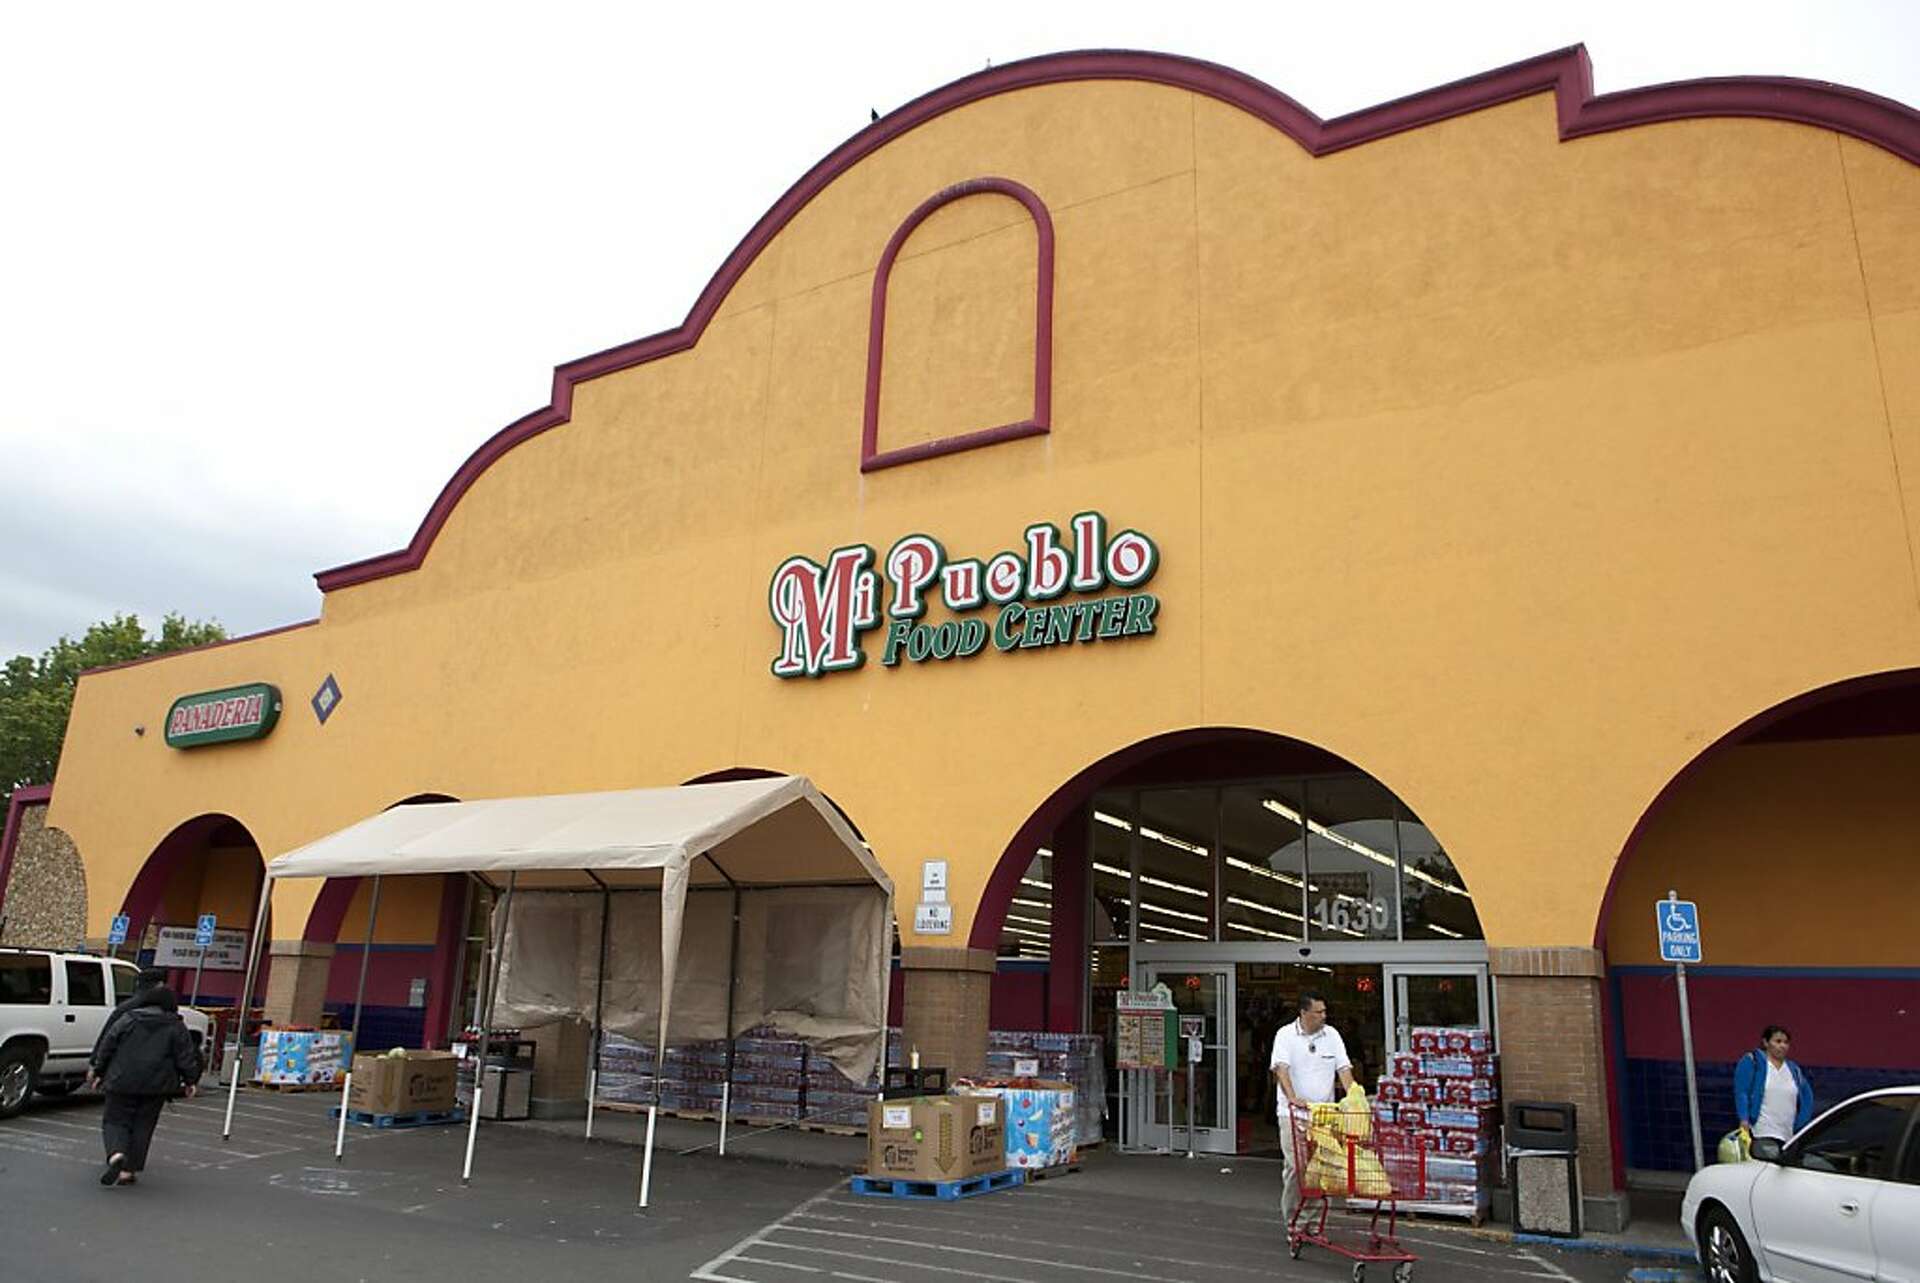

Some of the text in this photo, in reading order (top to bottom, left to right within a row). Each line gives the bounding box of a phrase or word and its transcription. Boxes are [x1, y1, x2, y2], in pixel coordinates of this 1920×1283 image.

[769, 512, 1159, 678] Mi Pueblo
[882, 595, 1160, 666] FOOD CENTER
[168, 693, 264, 737] PANADERIA
[1314, 897, 1389, 932] 1630
[1662, 931, 1698, 944] PARKING
[1669, 944, 1692, 957] ONLY
